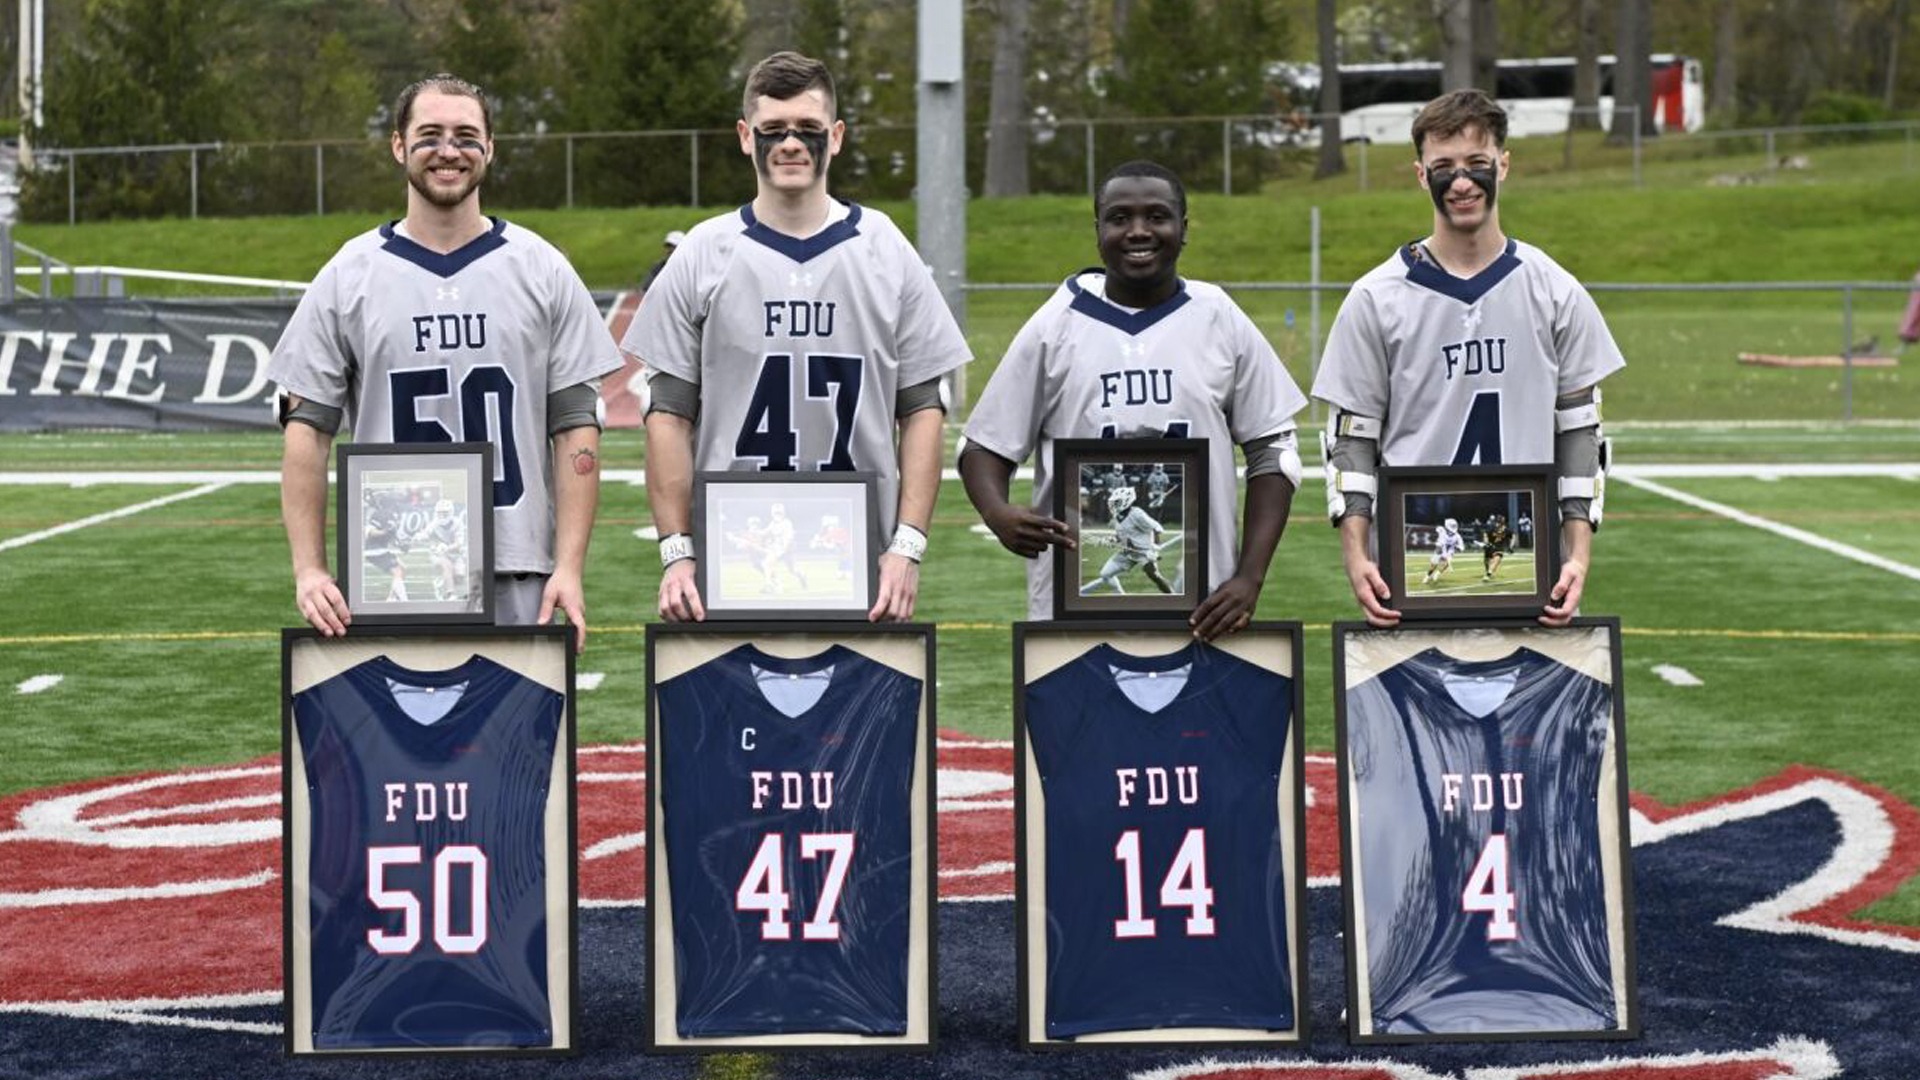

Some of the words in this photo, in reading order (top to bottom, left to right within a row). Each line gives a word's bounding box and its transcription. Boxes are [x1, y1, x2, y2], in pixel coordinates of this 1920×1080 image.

[412, 313, 487, 352] FDU
[763, 300, 836, 338] FDU
[0, 330, 172, 402] THE
[193, 334, 284, 403] D
[1441, 338, 1506, 380] FDU
[1100, 369, 1173, 408] FDU
[734, 353, 864, 471] 47
[388, 364, 525, 509] 50
[741, 727, 756, 751] C
[384, 782, 468, 822] FDU
[751, 771, 834, 810] FDU
[1116, 766, 1198, 807] FDU
[1441, 773, 1523, 812] FDU
[367, 844, 488, 955] 50
[736, 832, 855, 940] 47
[1114, 828, 1216, 939] 14
[1462, 834, 1517, 941] 4
